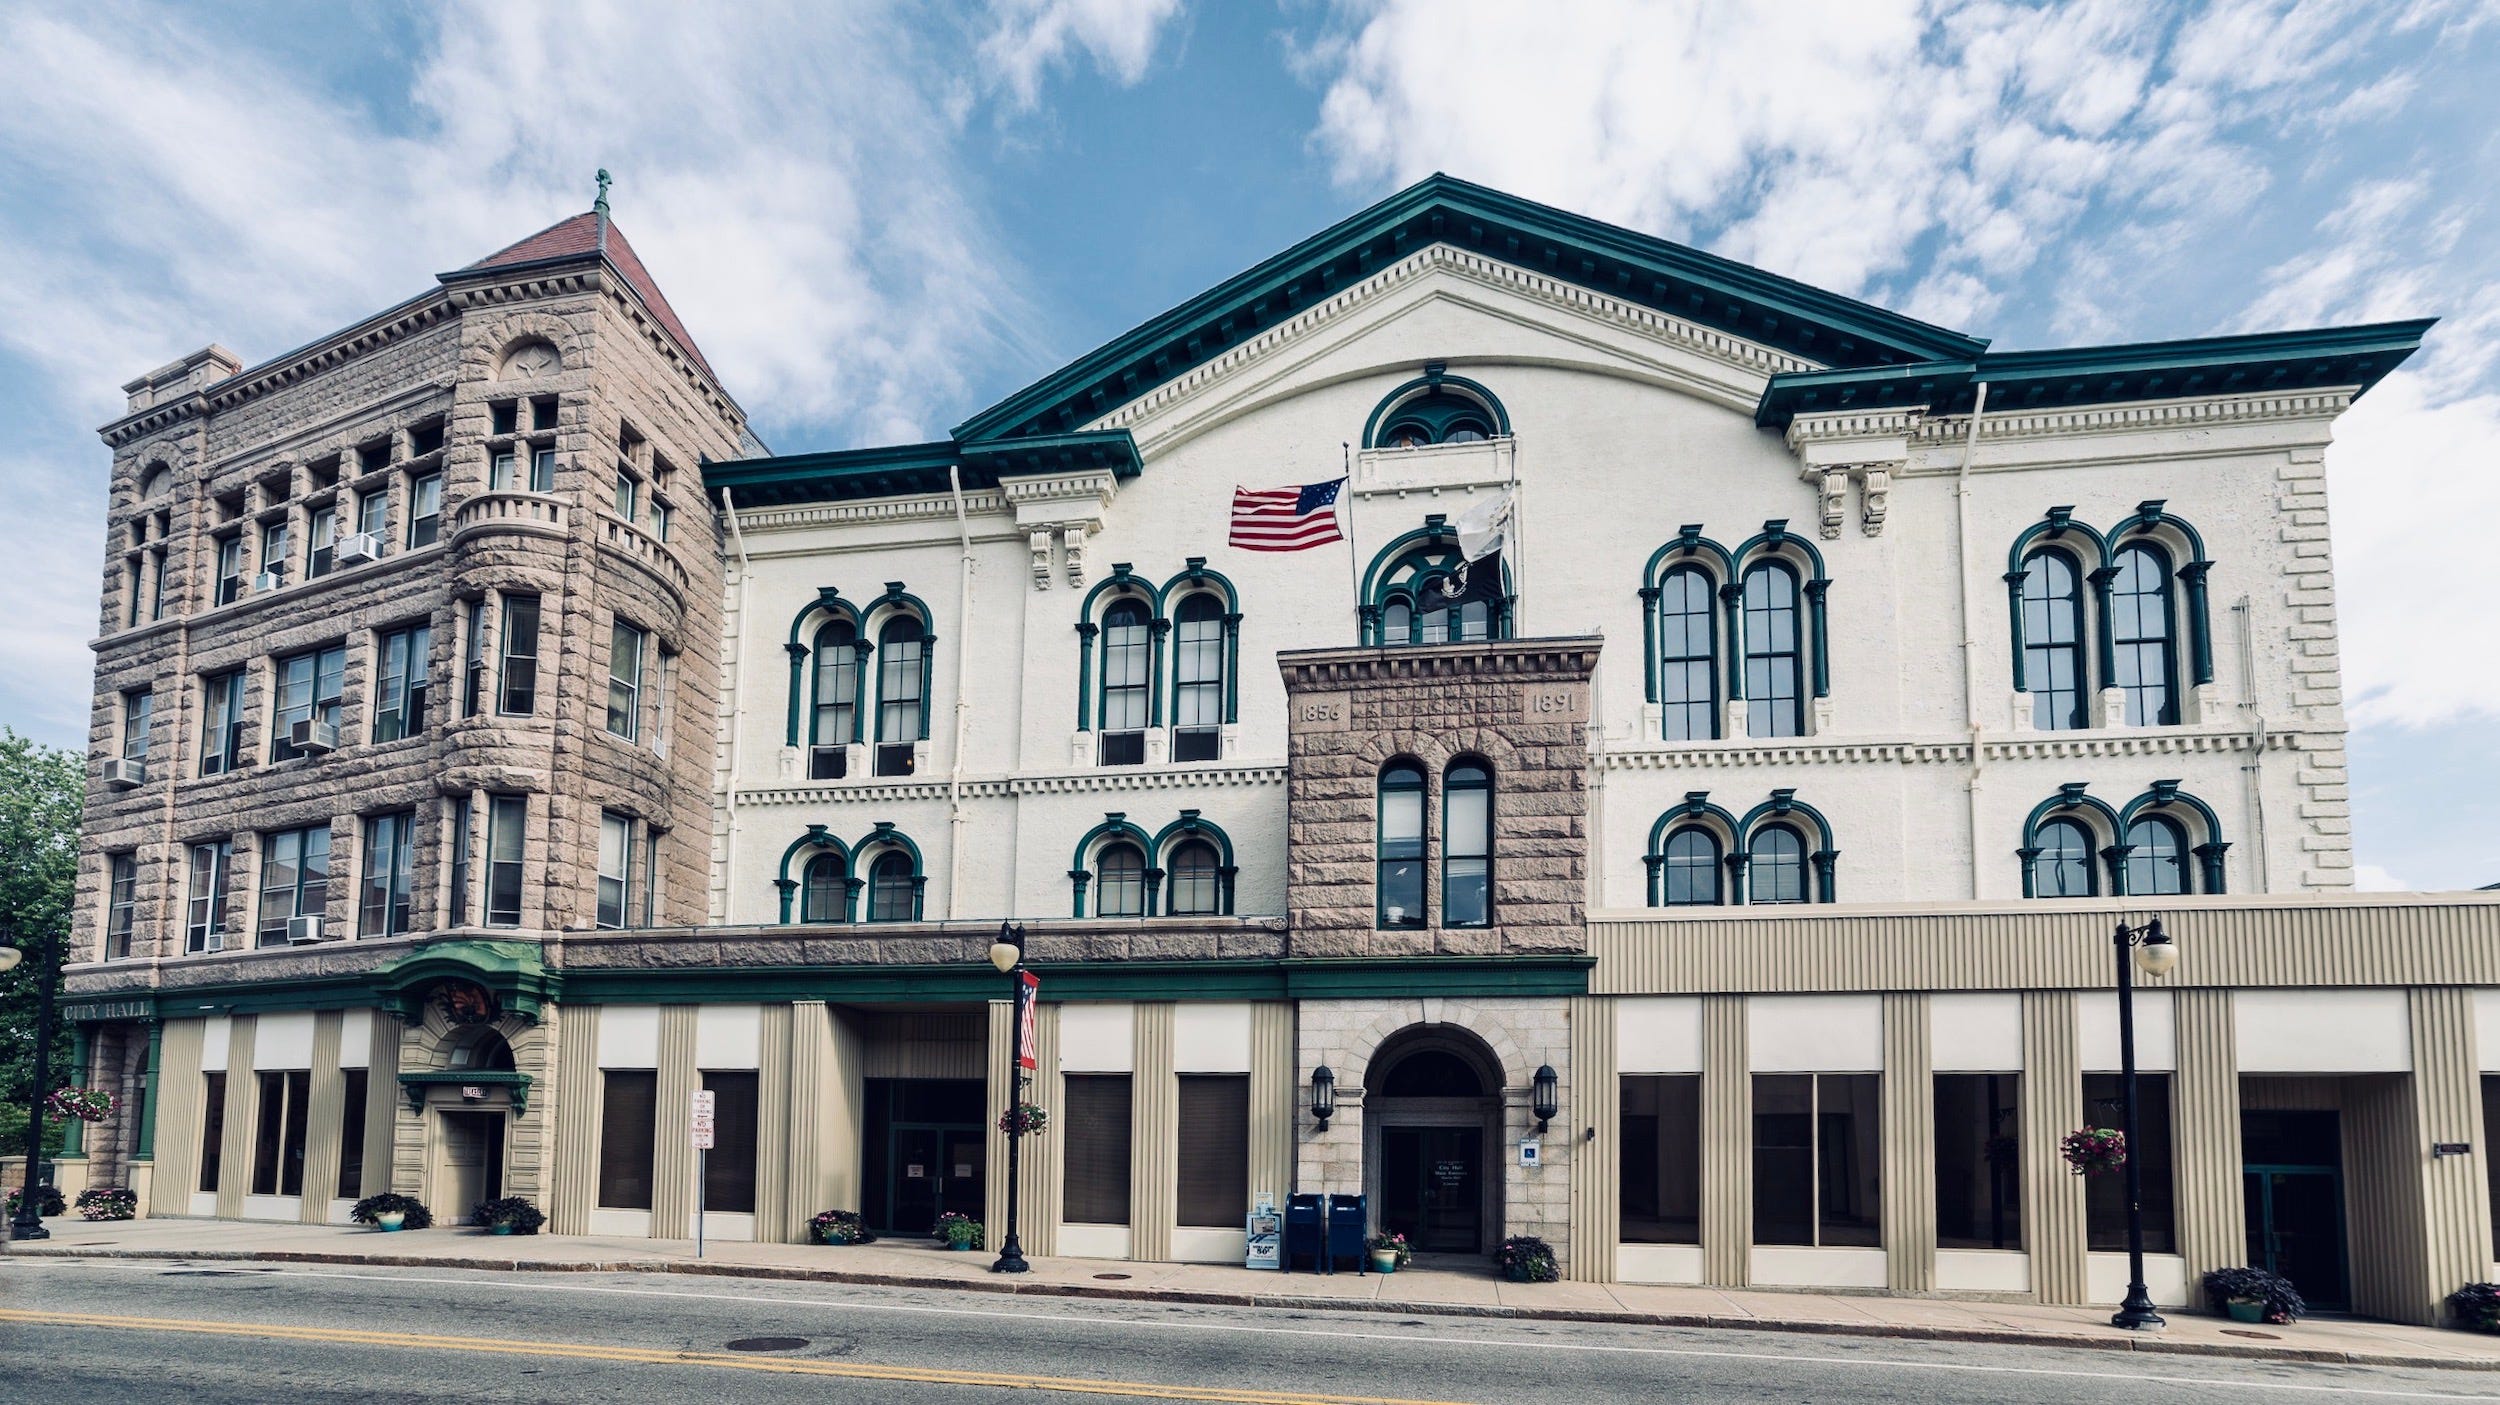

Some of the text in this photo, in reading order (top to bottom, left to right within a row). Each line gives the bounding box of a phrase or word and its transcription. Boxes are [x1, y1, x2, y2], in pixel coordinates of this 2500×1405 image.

[1532, 692, 1574, 713] 1891
[1300, 703, 1340, 722] 1856
[64, 1002, 149, 1020] CITY HALL
